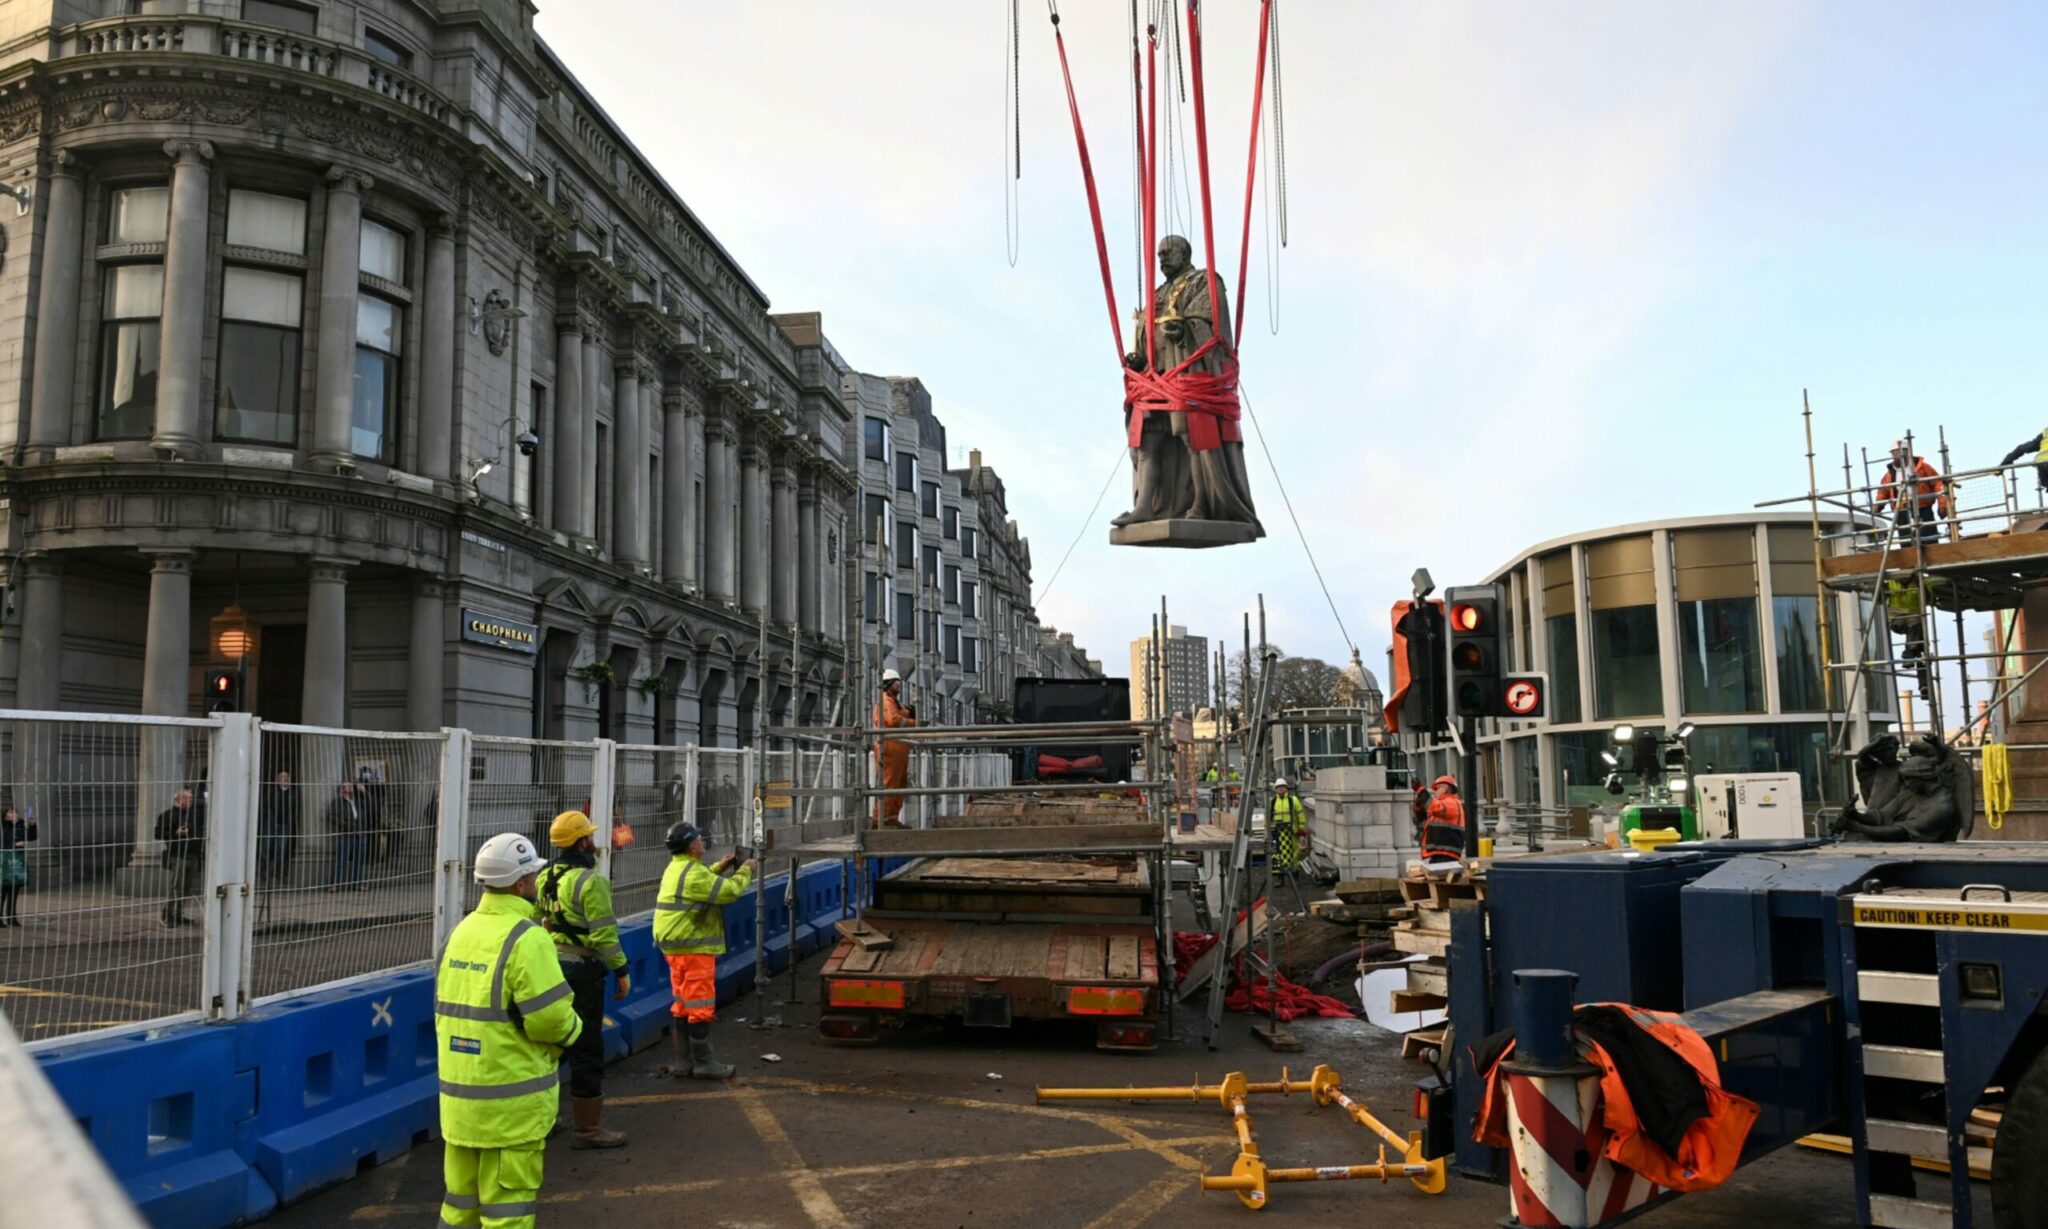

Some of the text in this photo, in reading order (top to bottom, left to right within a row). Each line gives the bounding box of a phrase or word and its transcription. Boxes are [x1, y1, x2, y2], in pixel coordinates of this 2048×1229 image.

[471, 620, 534, 644] CHAOPHRAYA
[1860, 909, 2010, 928] CAUTION! KEEP CLEAR
